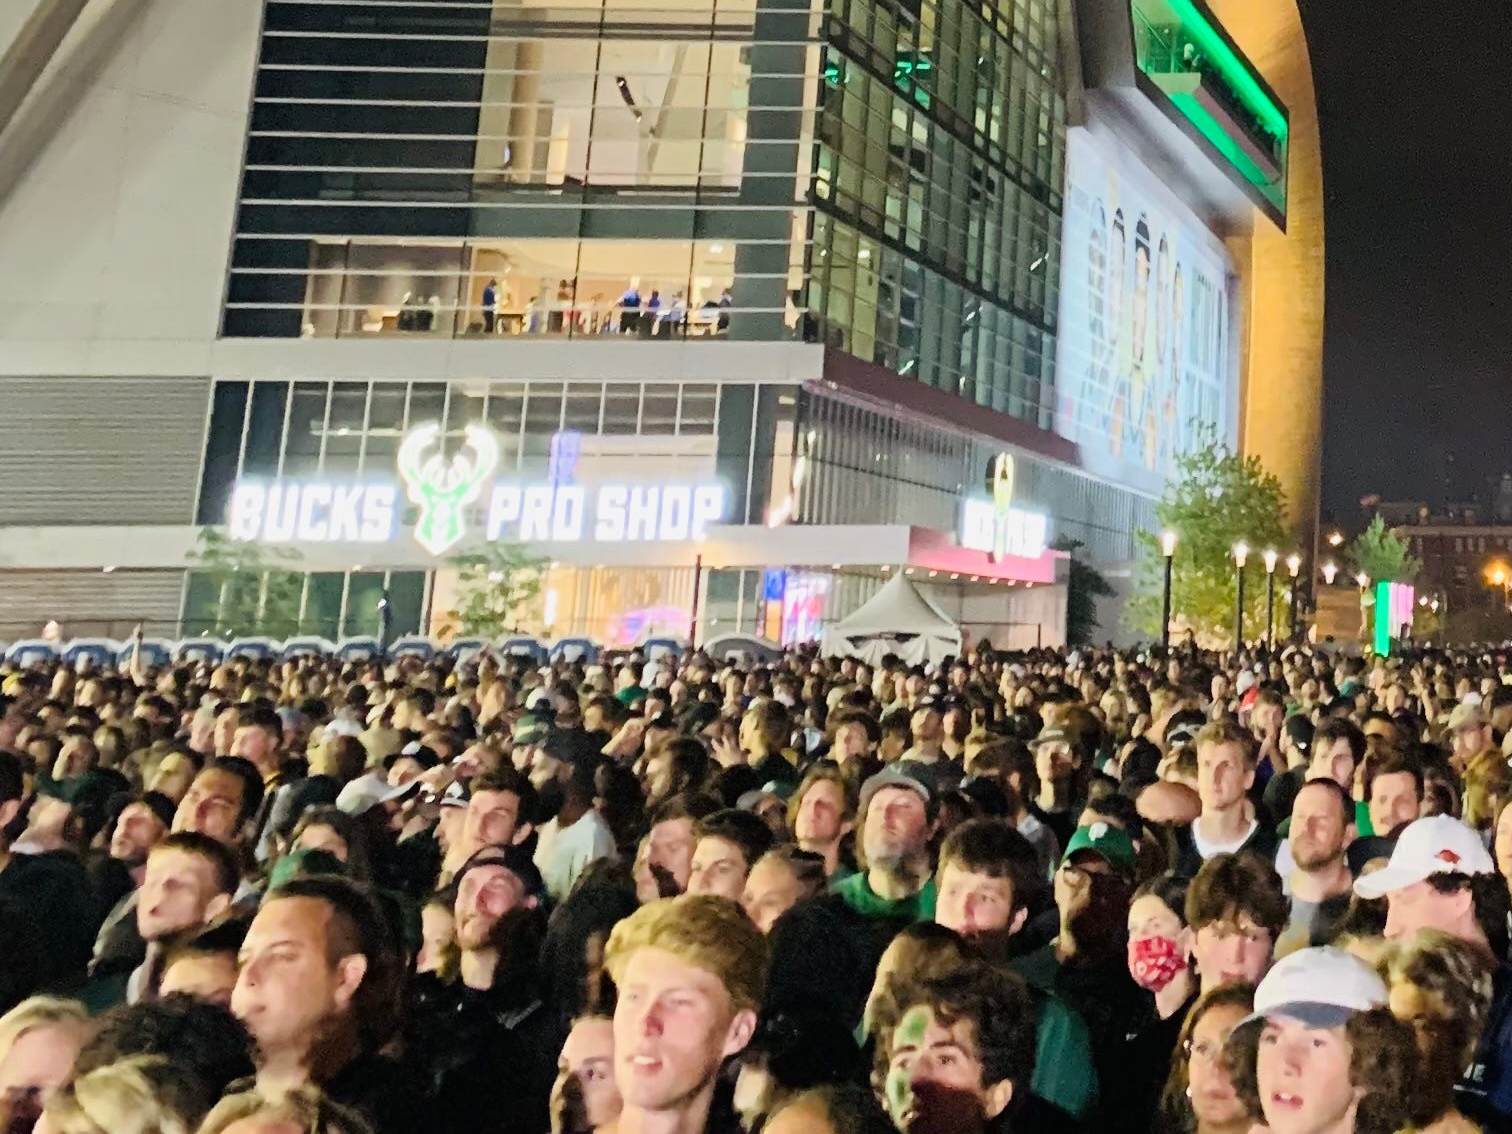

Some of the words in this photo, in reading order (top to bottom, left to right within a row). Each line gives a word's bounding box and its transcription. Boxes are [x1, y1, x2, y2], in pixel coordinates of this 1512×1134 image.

[229, 482, 396, 542] BUCKS
[486, 484, 585, 541] PRO
[595, 484, 724, 541] SHOP
